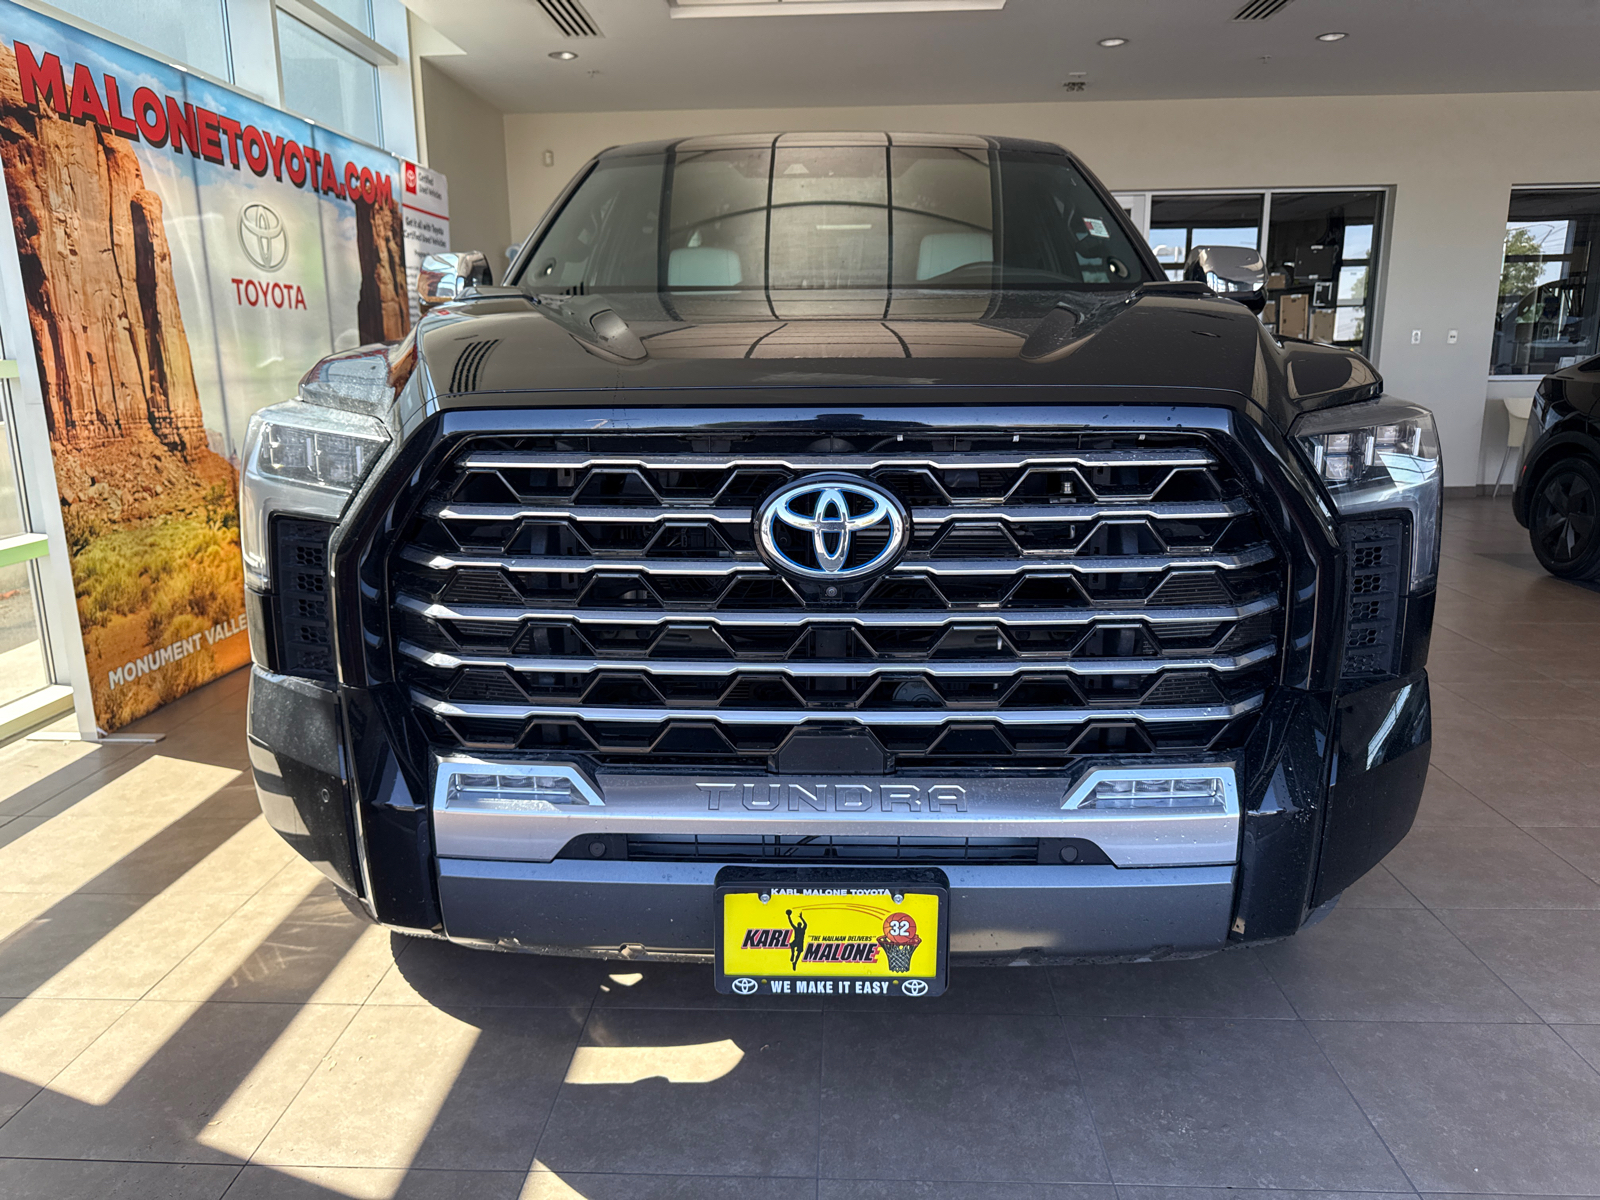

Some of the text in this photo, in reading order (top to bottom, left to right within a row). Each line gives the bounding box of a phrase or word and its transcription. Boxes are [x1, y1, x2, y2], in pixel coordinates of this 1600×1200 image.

[13, 40, 393, 209] MALONETOYOTA.COM
[231, 277, 307, 311] TOYOTA
[108, 613, 249, 691] MONUMENT VALLE
[695, 783, 969, 813] TUNDRA
[771, 888, 892, 896] KARL MALONE TOYOTA
[741, 928, 793, 950] KARL
[889, 920, 910, 937] 32
[802, 942, 881, 964] MALONE
[770, 980, 889, 994] WE MAKE IT EASY
